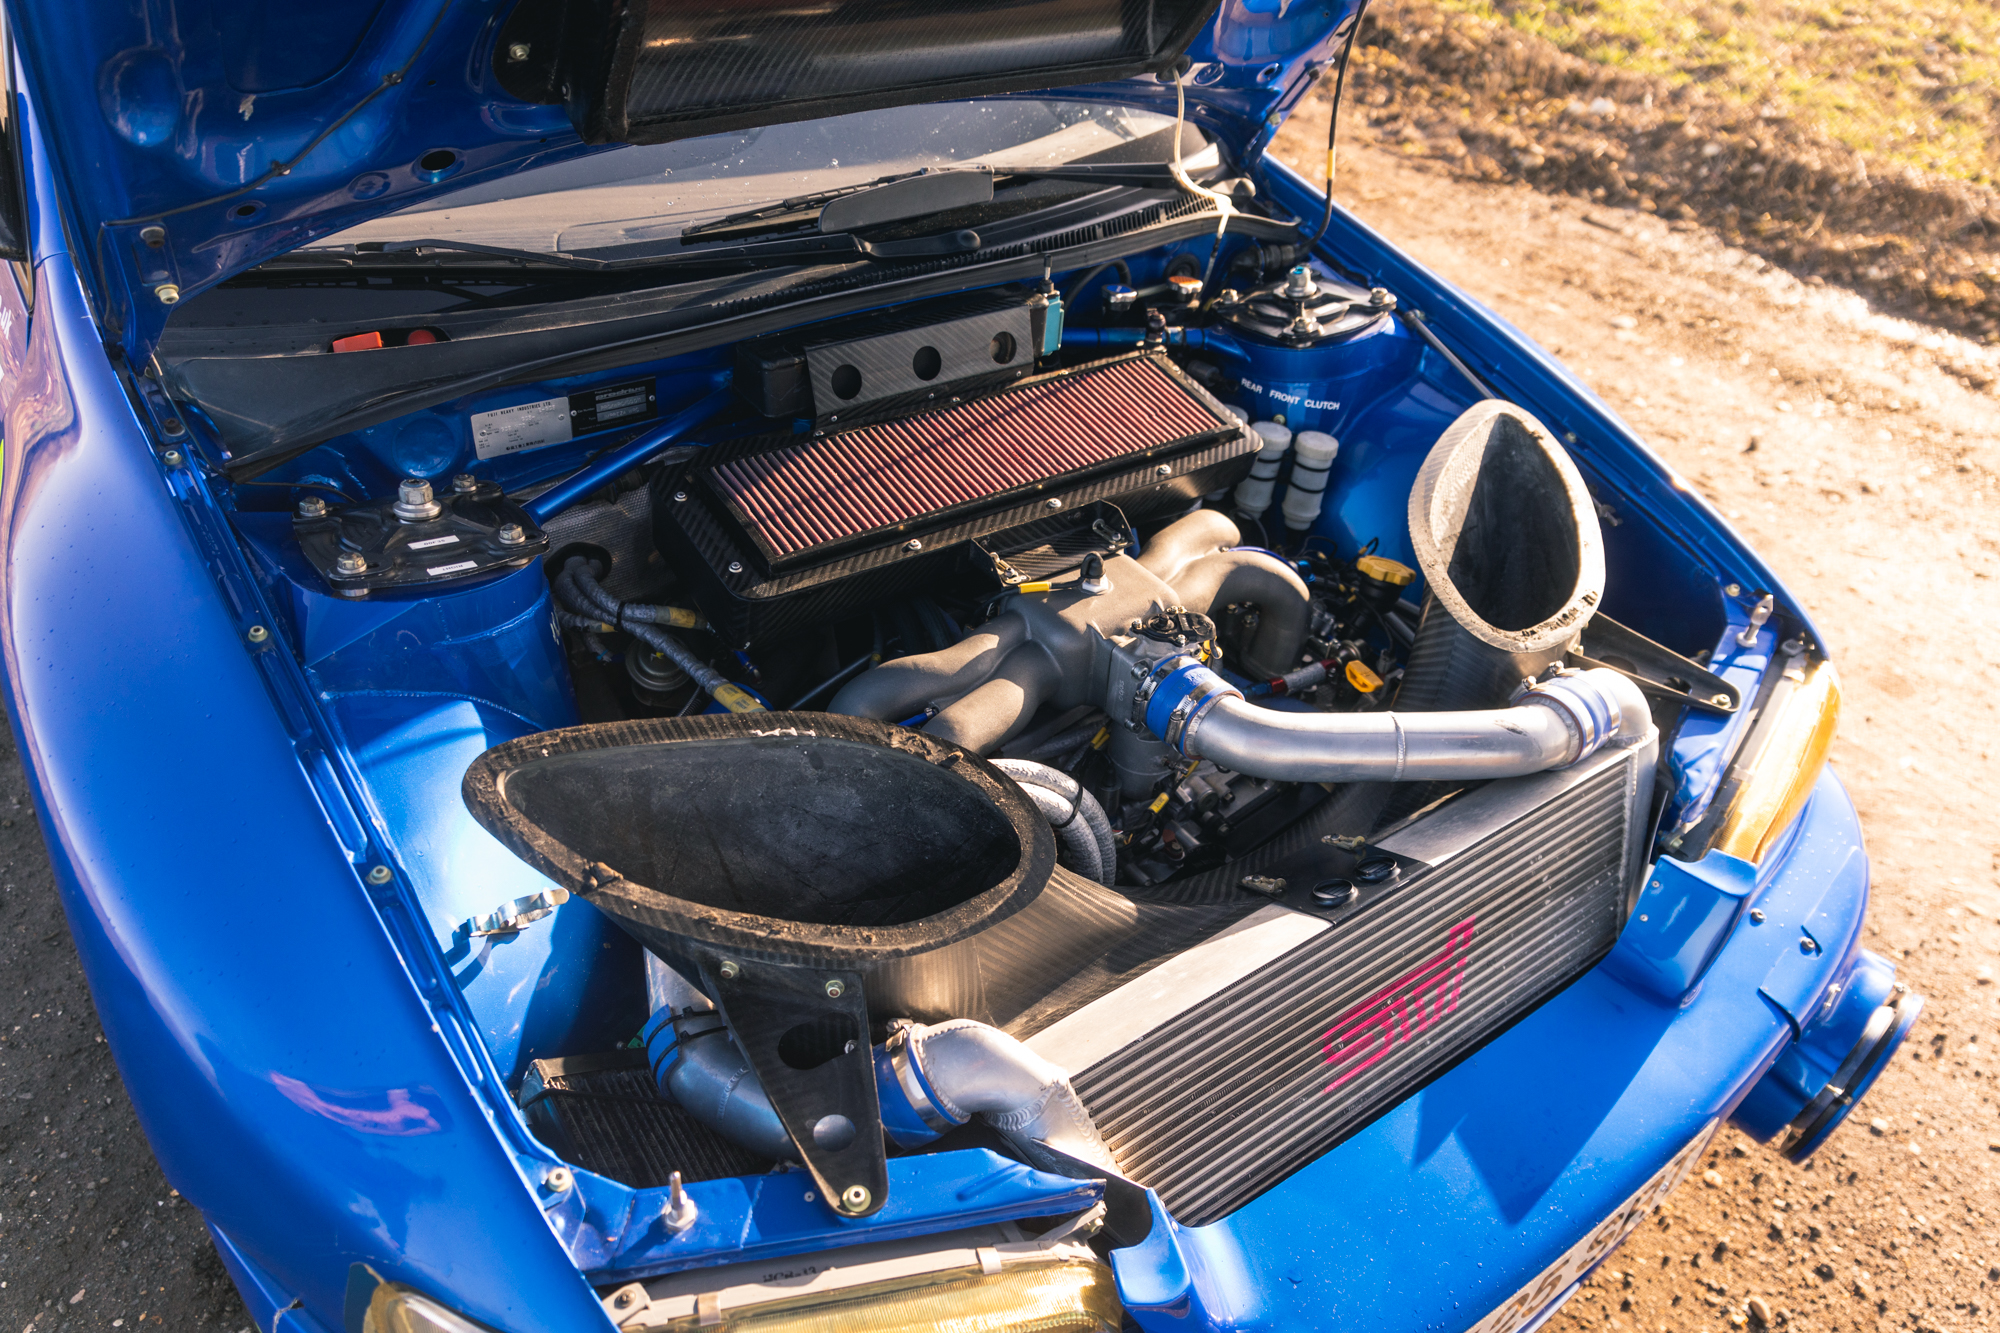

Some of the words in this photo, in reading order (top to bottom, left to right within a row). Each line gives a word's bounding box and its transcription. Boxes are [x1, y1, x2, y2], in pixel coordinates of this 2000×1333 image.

[517, 403, 541, 412] INDUSTRIES
[1241, 377, 1263, 394] REAR
[1269, 389, 1301, 405] FRONT
[1304, 399, 1340, 411] CLUTCH
[1475, 1254, 1573, 1333] 25
